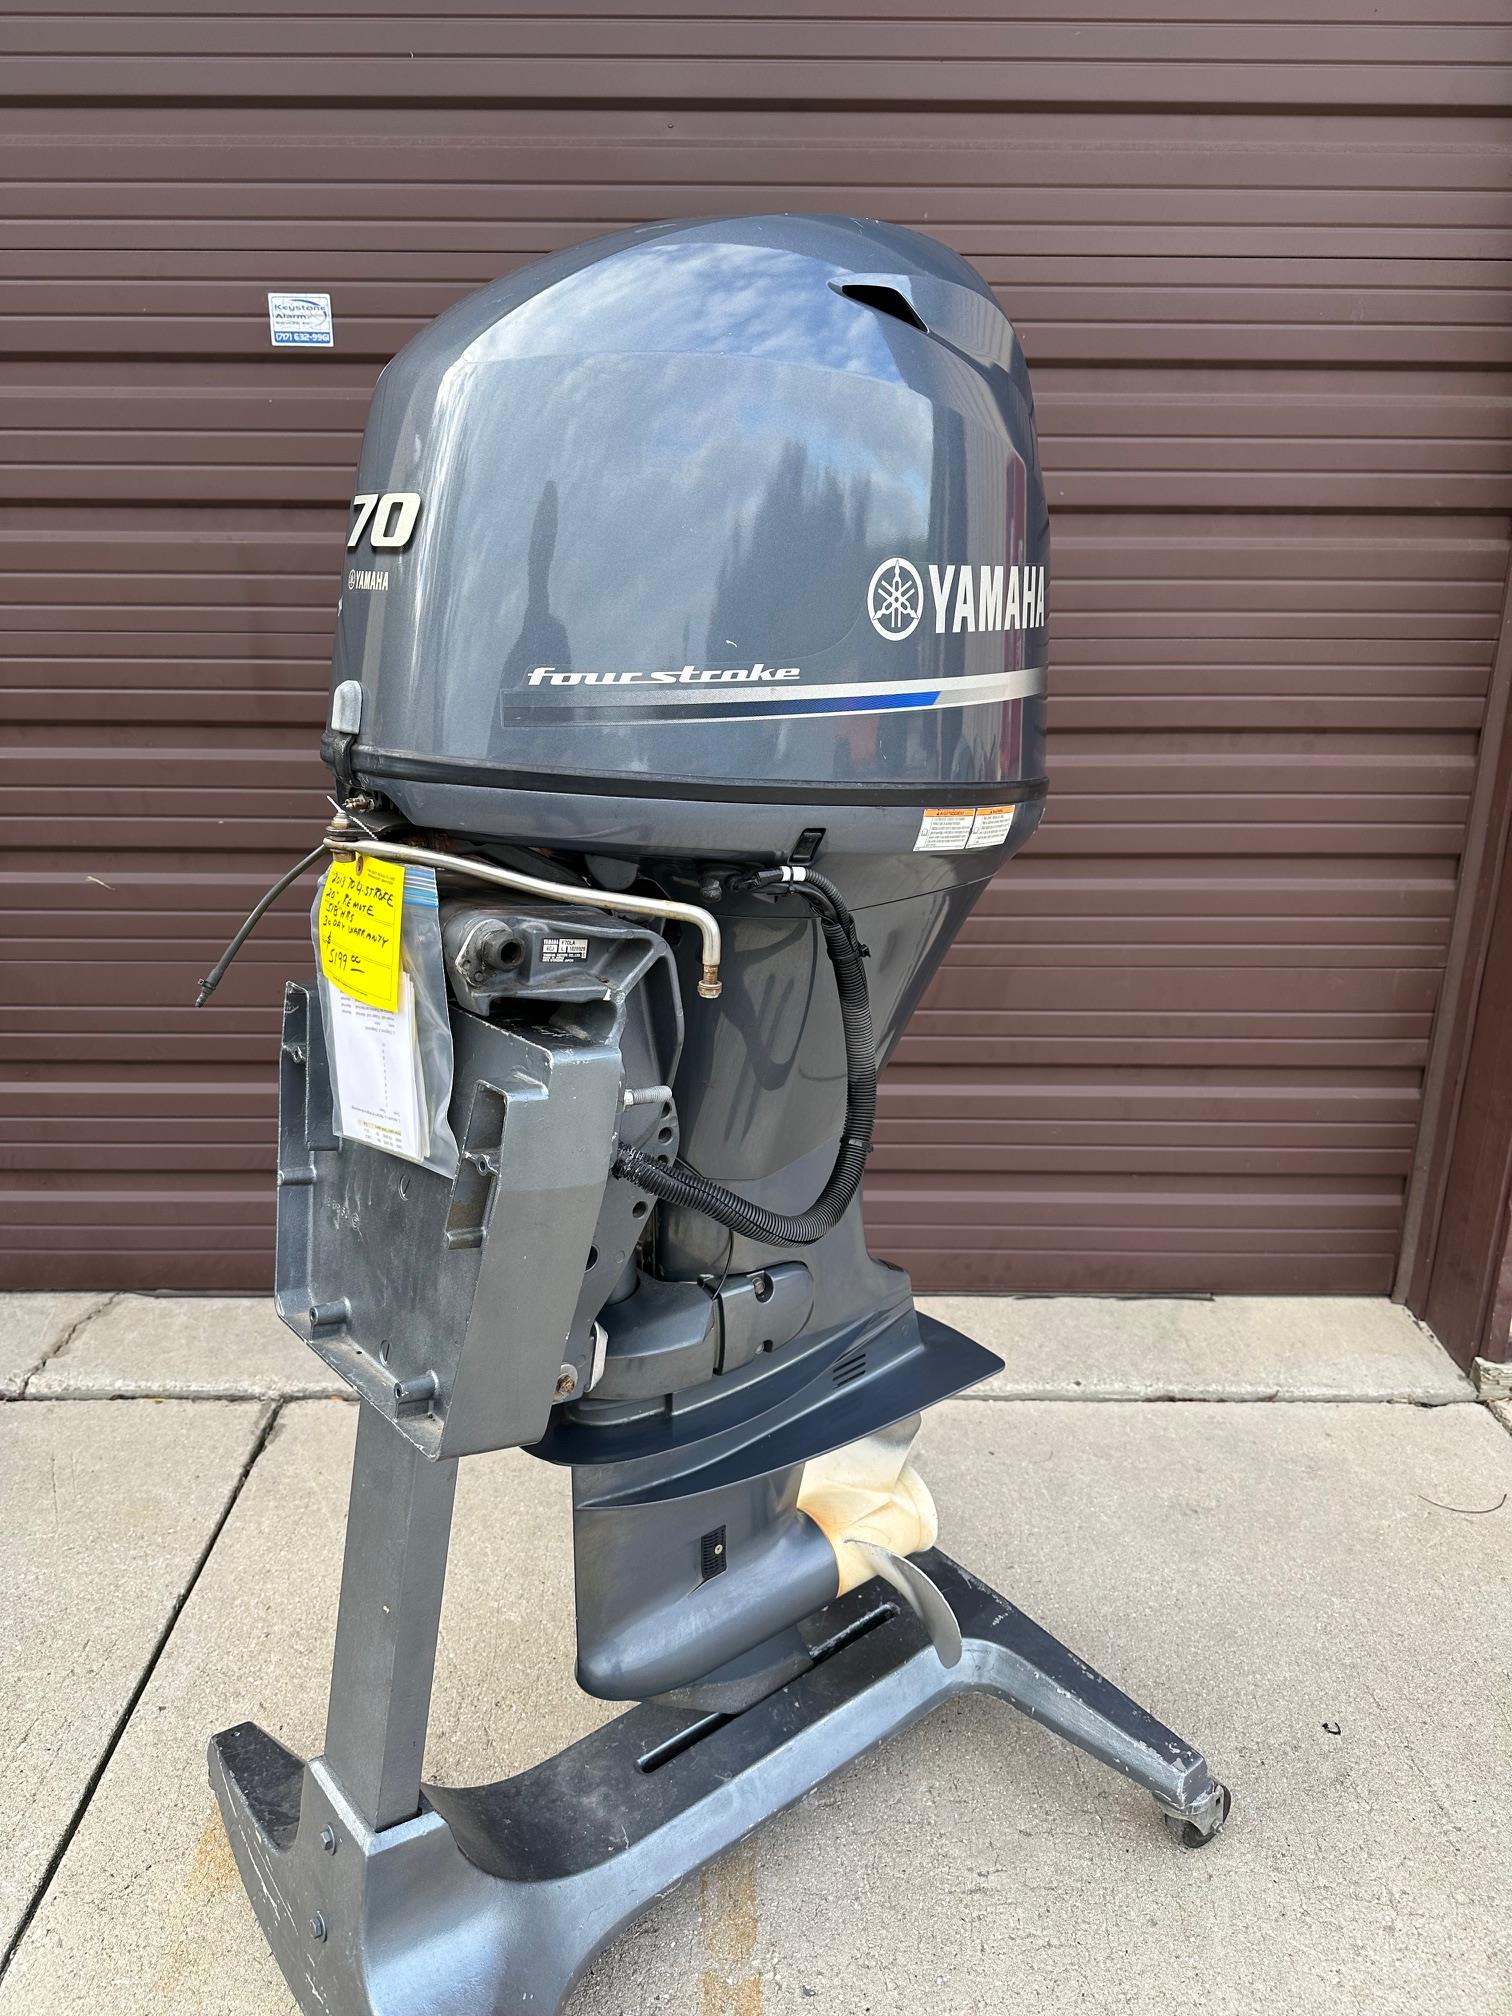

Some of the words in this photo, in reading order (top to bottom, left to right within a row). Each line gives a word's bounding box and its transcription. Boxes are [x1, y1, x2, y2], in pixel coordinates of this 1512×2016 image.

[274, 304, 326, 312] Keystone
[347, 493, 421, 547] 70
[355, 570, 389, 592] YAMAHA
[927, 564, 1046, 635] YAMAHA
[527, 667, 645, 686] four
[648, 663, 800, 684] stroke
